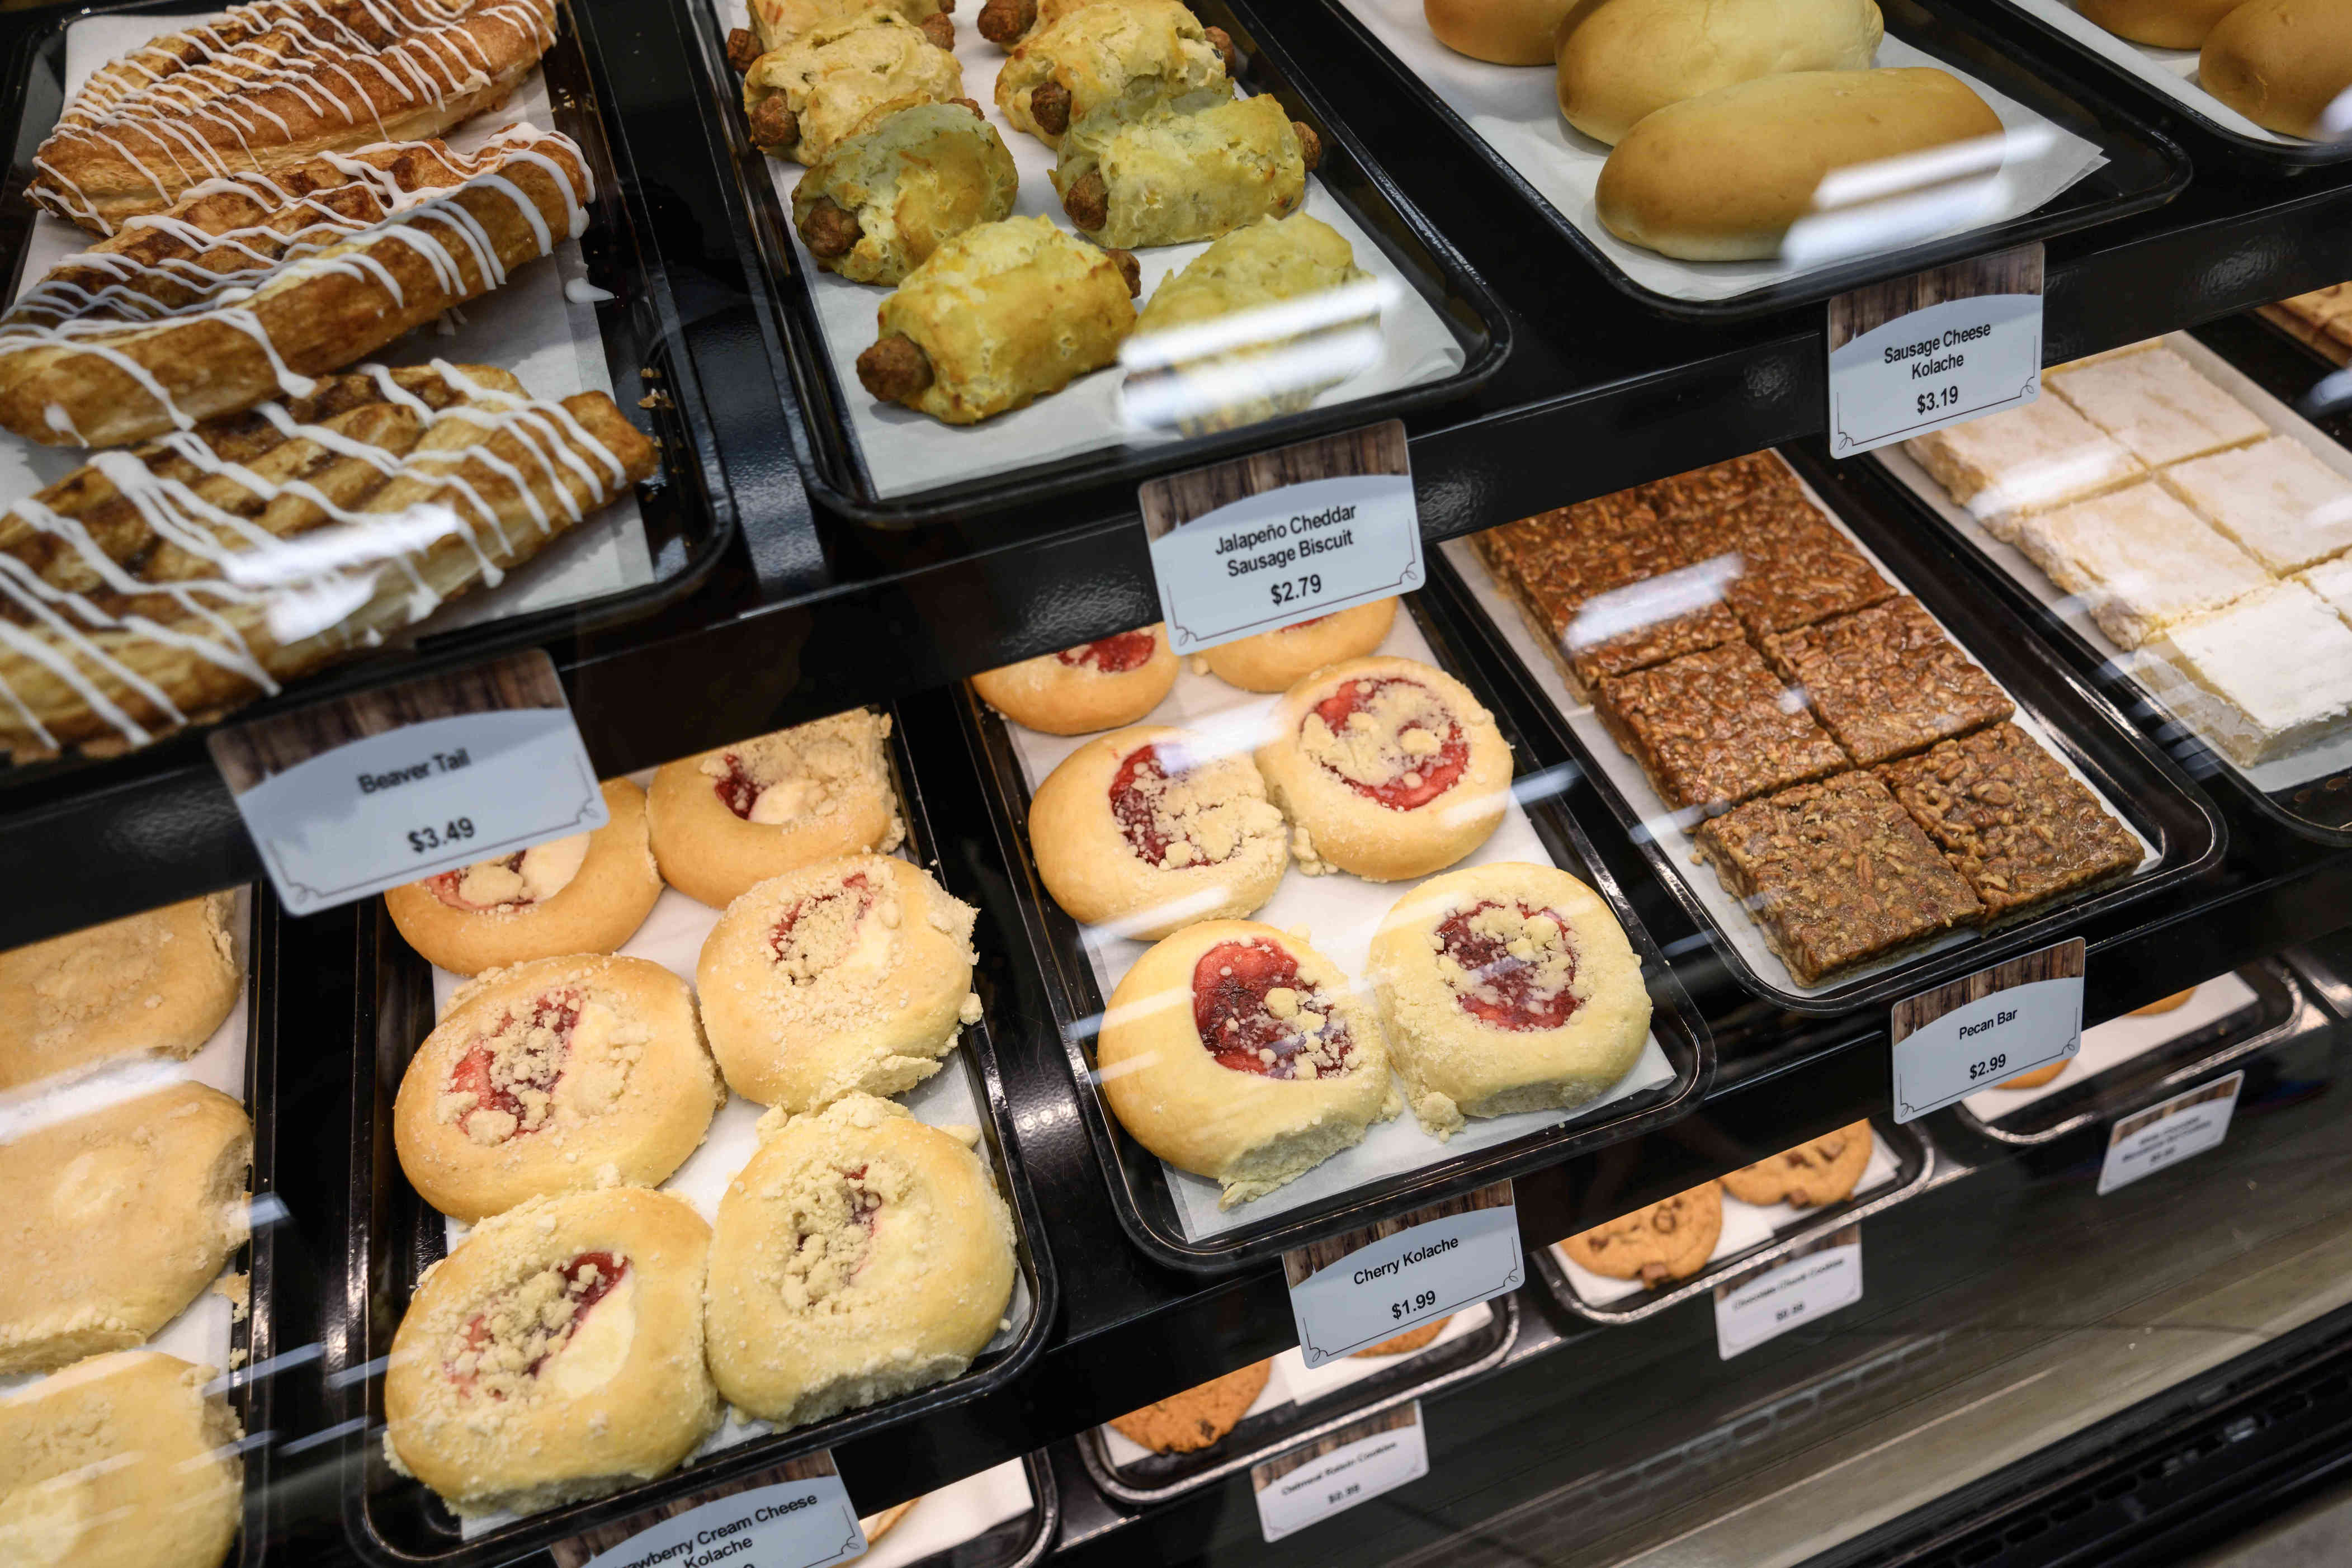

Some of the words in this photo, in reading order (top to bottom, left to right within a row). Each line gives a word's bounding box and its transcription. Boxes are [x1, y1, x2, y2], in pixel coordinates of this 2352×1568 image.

[1884, 338, 1940, 363] Sausage
[1943, 324, 1991, 347] Cheese
[1911, 355, 1964, 380] Kolache
[1917, 386, 1958, 415] $3.19
[1215, 525, 1287, 555] Jalapeño
[1290, 505, 1356, 534] Cheddar
[1227, 548, 1296, 577] Sausage
[1298, 529, 1354, 558] Biscuit
[1271, 574, 1321, 606] $2.79
[357, 762, 430, 794] Beaver
[432, 747, 471, 772] Tail
[407, 816, 475, 853] $3.49
[1959, 1019, 1994, 1040] Pecan
[1997, 1009, 2018, 1026] Bar
[1970, 1054, 2006, 1080] $2.99
[1353, 1259, 1400, 1284] Cherry
[1402, 1238, 1459, 1267] Kolache
[1391, 1290, 1436, 1320] $1.99
[697, 1517, 753, 1545] Cream
[755, 1494, 818, 1523] Cheese
[683, 1537, 753, 1568] Kolache
